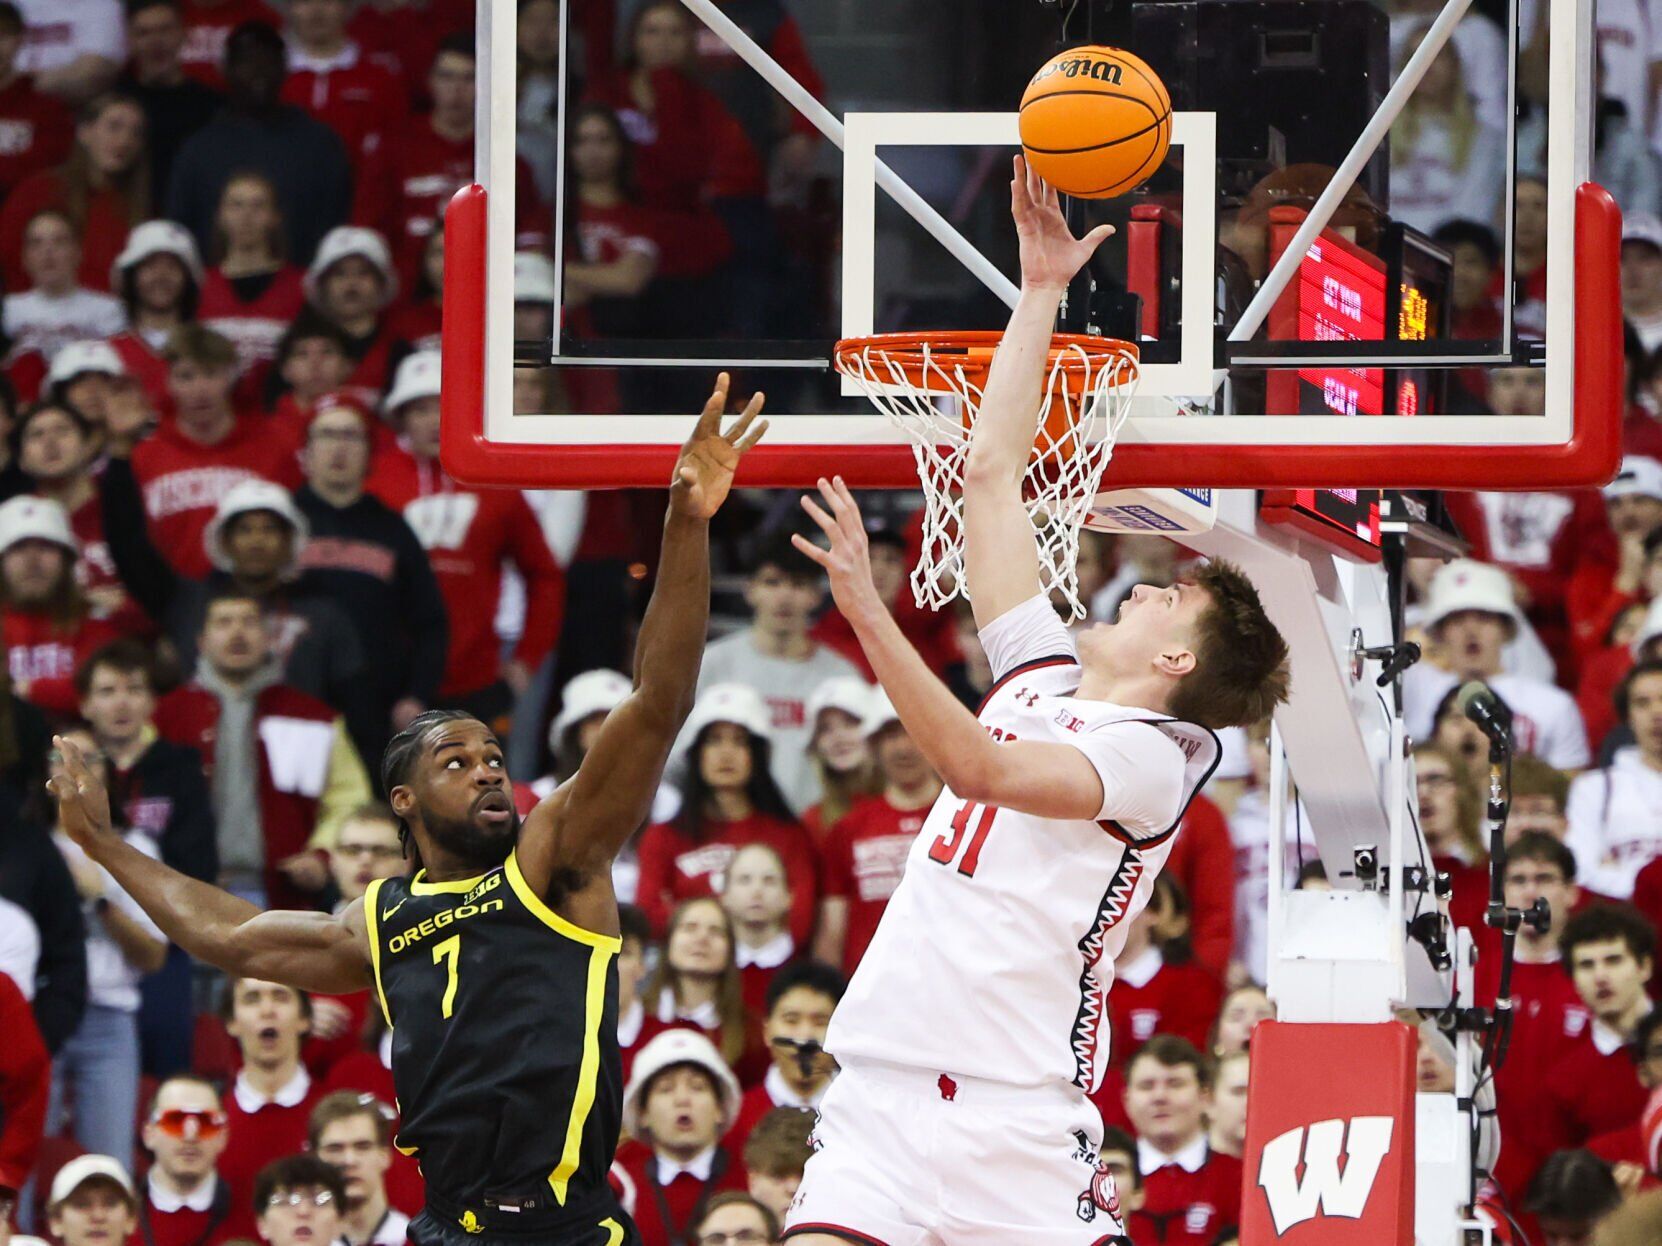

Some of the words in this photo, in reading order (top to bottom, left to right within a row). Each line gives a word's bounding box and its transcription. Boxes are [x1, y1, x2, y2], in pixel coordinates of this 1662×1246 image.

[928, 800, 999, 879] 31
[388, 898, 504, 954] OREGON
[431, 933, 461, 1020] 7
[1257, 1115, 1395, 1237] W
